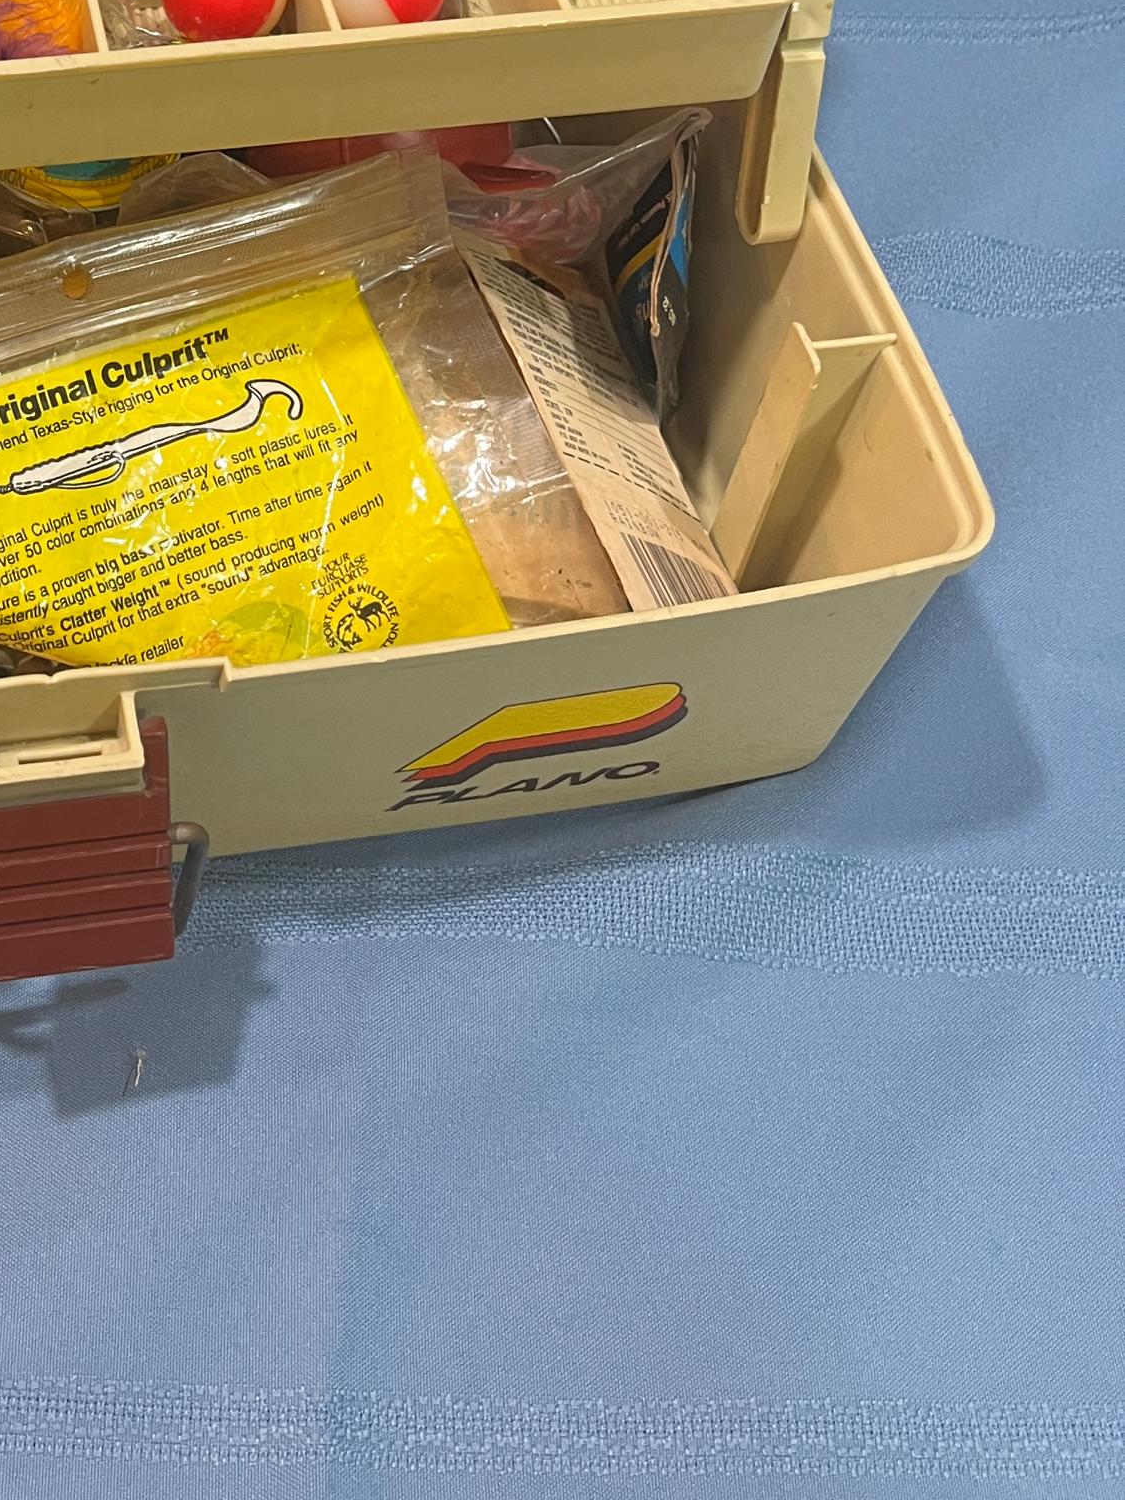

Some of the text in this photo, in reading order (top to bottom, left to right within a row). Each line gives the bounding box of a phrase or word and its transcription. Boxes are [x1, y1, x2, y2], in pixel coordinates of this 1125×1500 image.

[101, 327, 229, 388] Culprit™
[30, 408, 106, 439] Texas-Style
[107, 391, 155, 414] rigging
[155, 381, 174, 397] for
[176, 374, 200, 390] the
[201, 357, 252, 381] Original
[24, 542, 43, 559] 50
[46, 529, 77, 551] color
[79, 497, 165, 538] combinations
[170, 483, 196, 505] and
[200, 478, 210, 493] 4
[213, 460, 262, 488] lengths
[264, 449, 290, 470] that
[293, 442, 316, 462] will
[317, 436, 332, 453] fit
[336, 428, 359, 450] any
[31, 512, 73, 538] Culprit
[77, 506, 89, 522] is
[91, 498, 118, 519] truly
[122, 487, 145, 504] the
[149, 462, 208, 493] mainstay
[231, 445, 257, 465] soft
[259, 431, 302, 458] plastic
[304, 420, 341, 441] lures.
[344, 413, 354, 427] It
[24, 587, 37, 602] is
[40, 585, 49, 597] a
[51, 567, 95, 596] proven
[95, 556, 119, 577] big
[227, 506, 261, 525] Time
[264, 494, 293, 515] after
[295, 484, 323, 503] time
[326, 469, 362, 493] again
[363, 461, 373, 474] it
[52, 584, 96, 612] caught
[96, 570, 137, 595] bigger
[140, 558, 165, 577] and
[167, 542, 207, 566] better
[210, 529, 249, 550] bass.
[59, 607, 107, 632] Clatter
[231, 536, 296, 569] producing
[340, 493, 384, 526] weight)
[317, 566, 369, 600] SUPPORTS
[322, 552, 350, 573] YOUR
[71, 623, 116, 645] Culprit
[118, 614, 135, 630] for
[137, 603, 163, 622] that
[165, 589, 200, 610] extra
[201, 566, 253, 597] "sound"
[258, 545, 329, 576] advantage.
[328, 590, 347, 613] FISH
[357, 583, 400, 618] WILDLIFE
[139, 634, 185, 663] retailer
[323, 614, 338, 649] SPORT
[384, 761, 660, 812] PLANO
